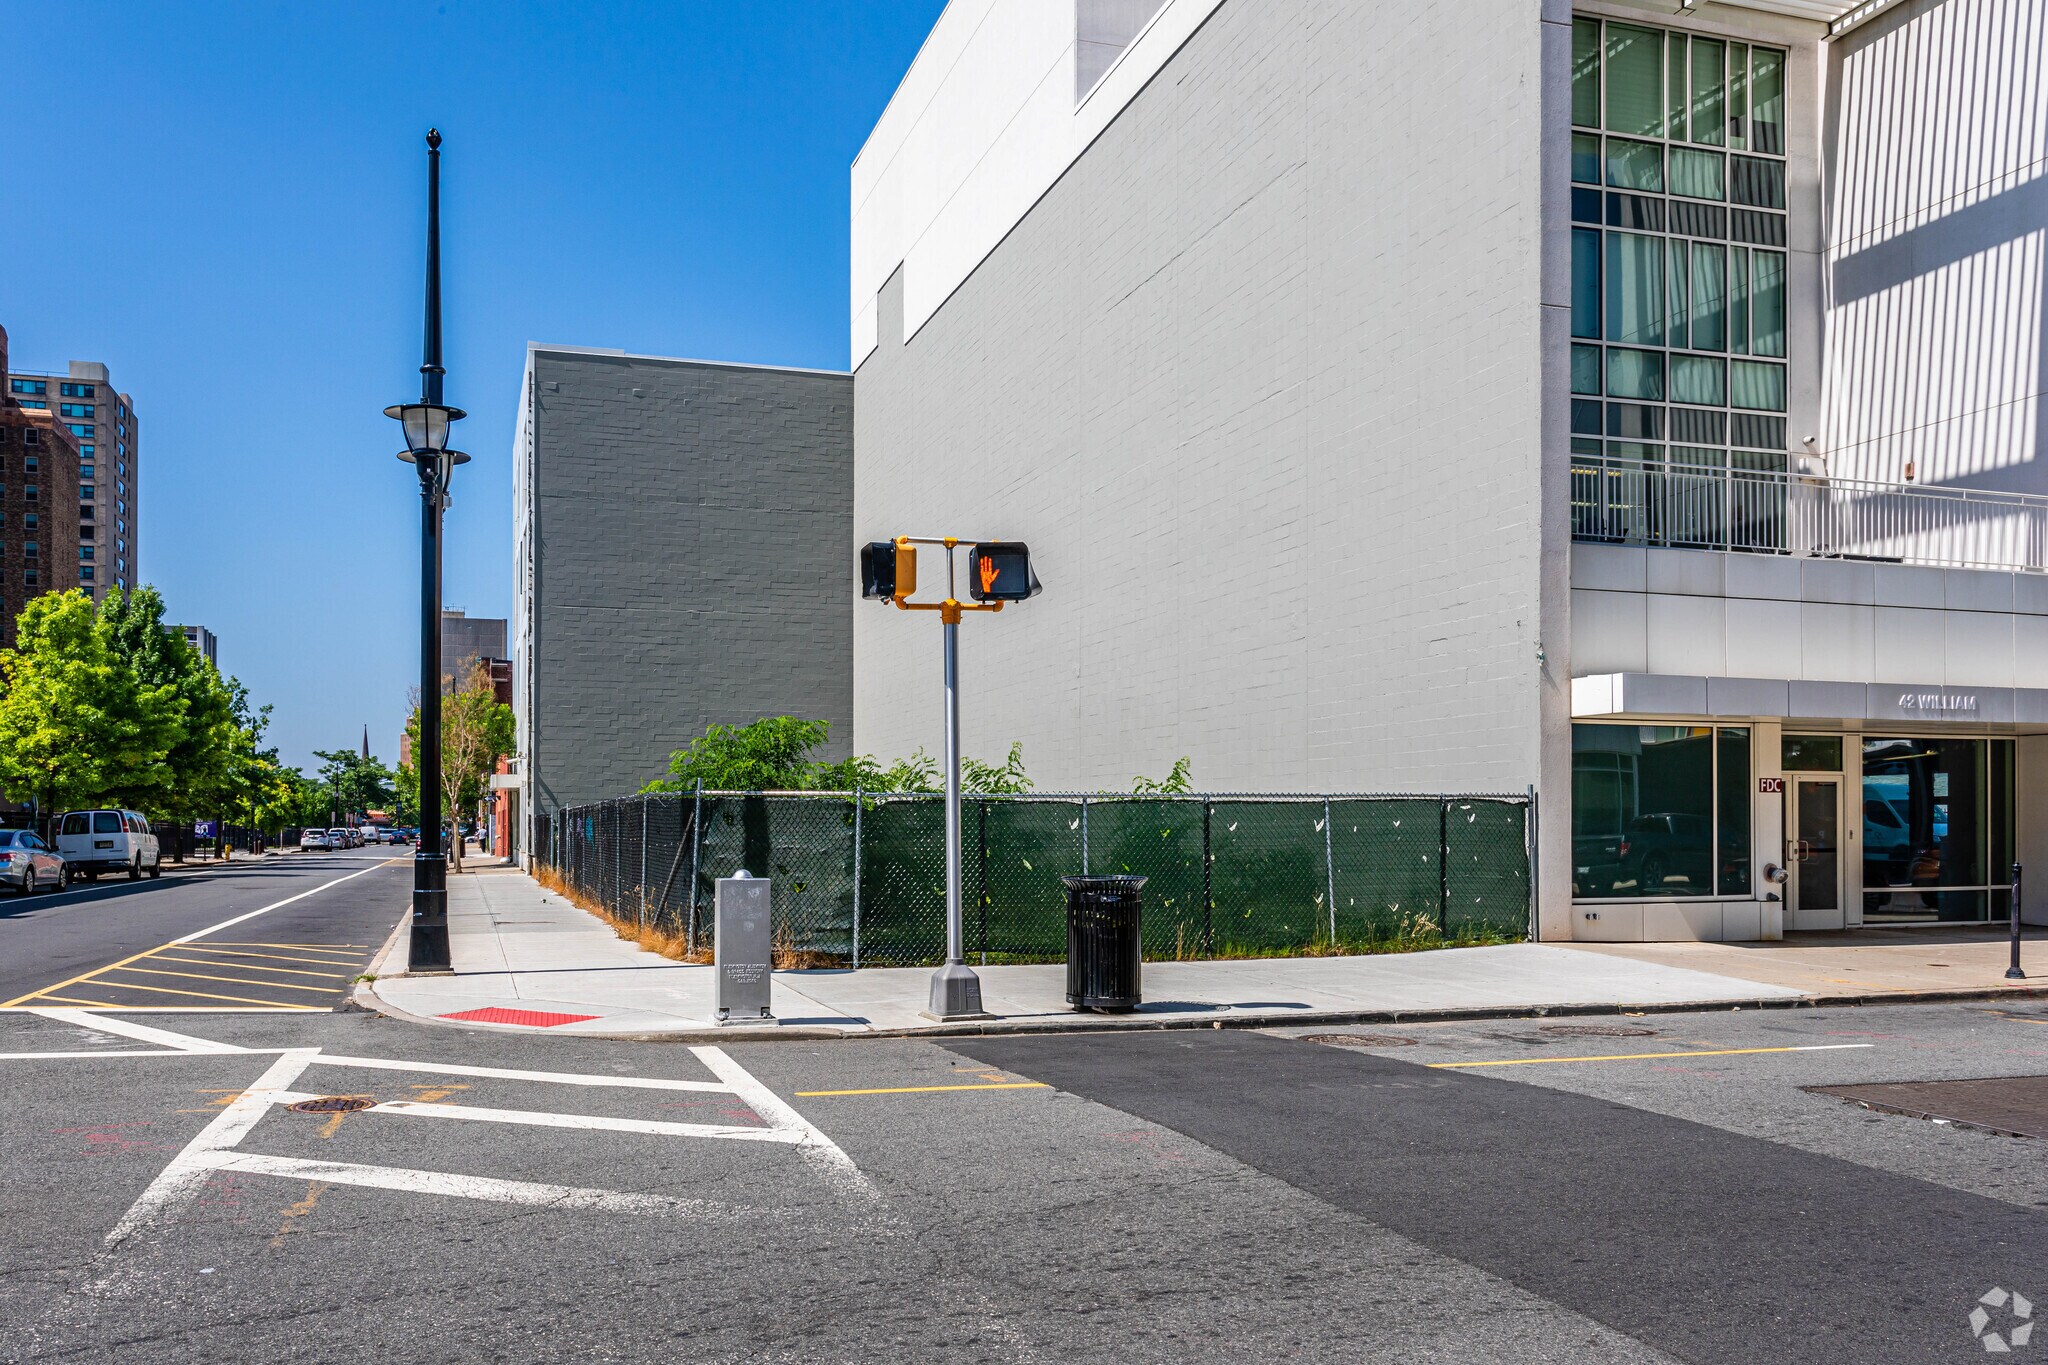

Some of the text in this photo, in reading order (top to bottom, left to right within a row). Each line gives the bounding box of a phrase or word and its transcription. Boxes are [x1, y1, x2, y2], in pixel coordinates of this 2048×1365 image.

[1898, 694, 1977, 710] 42 WILLIAM
[1760, 778, 1781, 792] FDC
